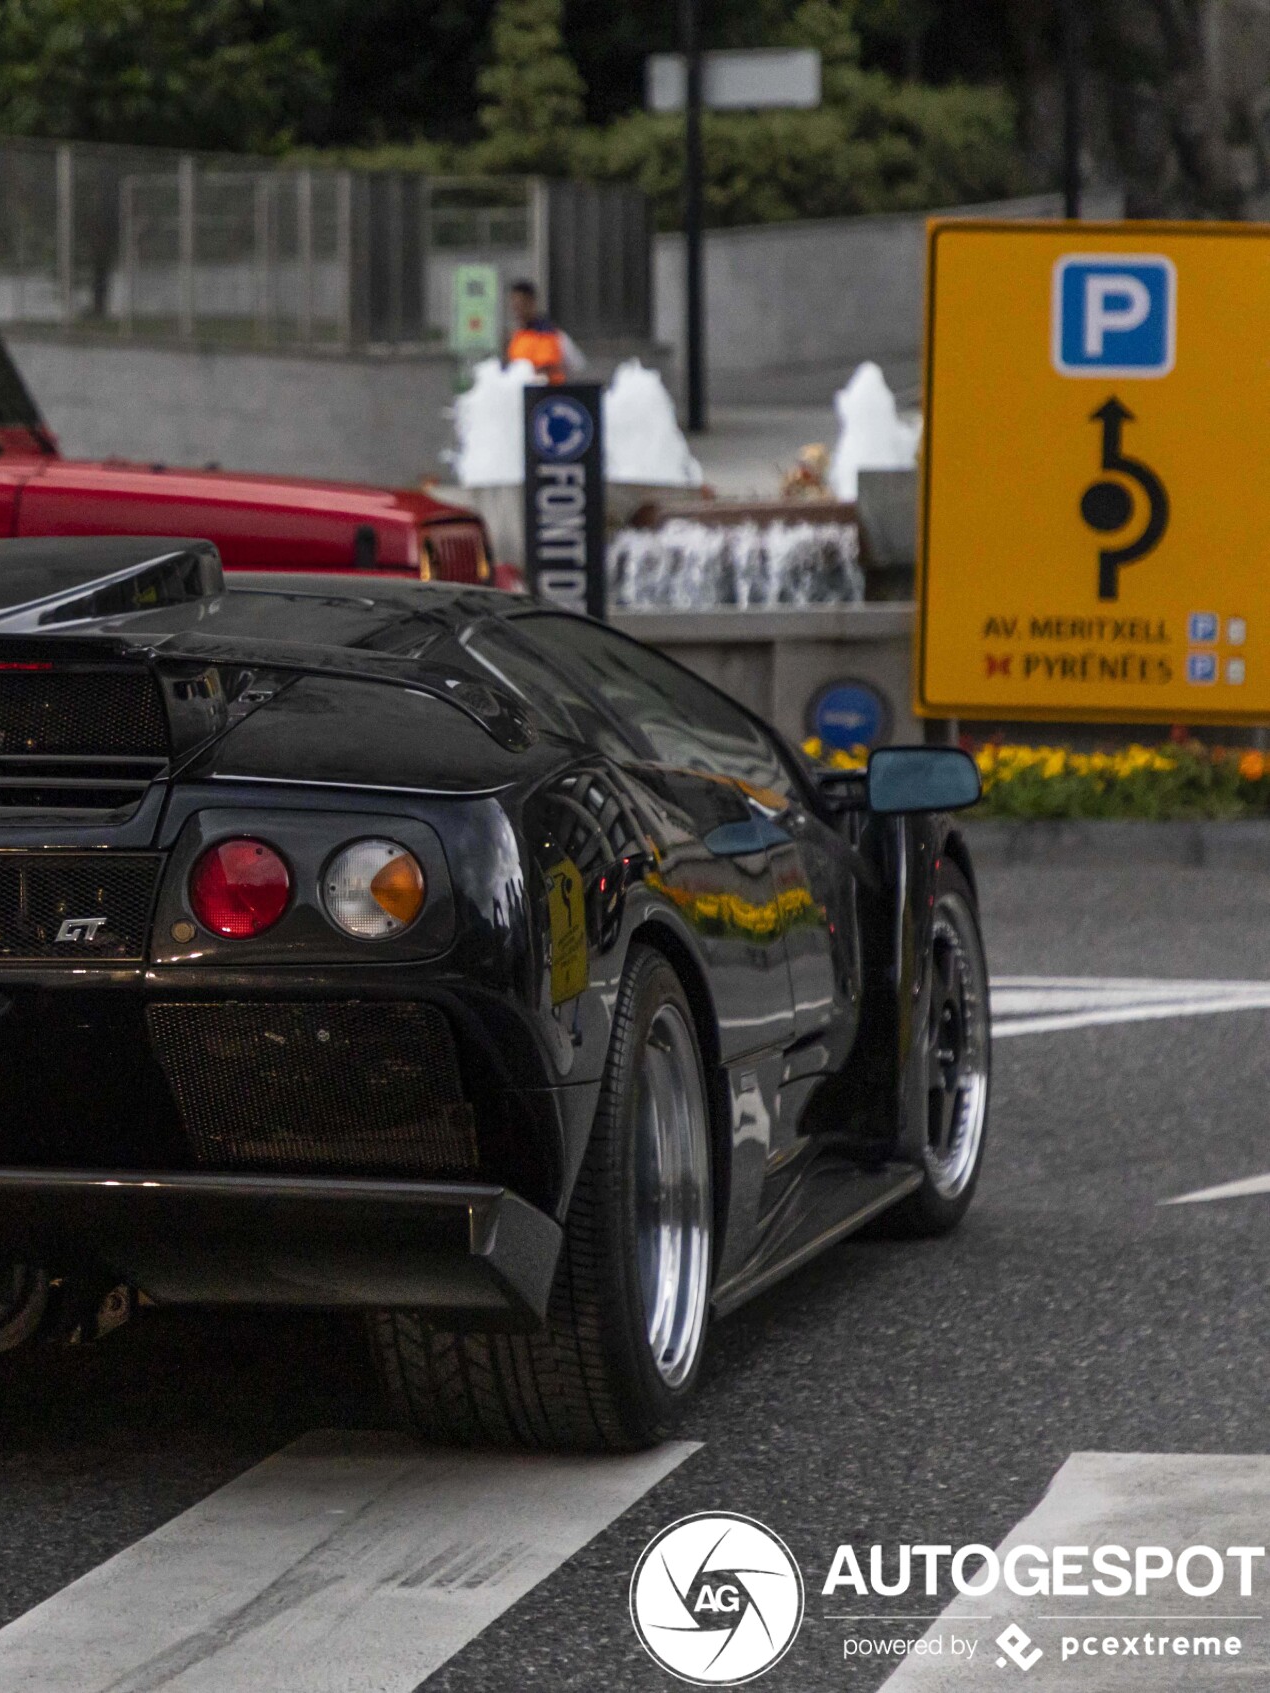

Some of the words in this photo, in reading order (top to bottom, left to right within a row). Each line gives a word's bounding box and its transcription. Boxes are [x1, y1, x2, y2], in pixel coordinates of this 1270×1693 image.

[1084, 274, 1151, 357] P
[536, 463, 587, 566] FONT
[1029, 615, 1172, 644] MERITXELL
[54, 917, 107, 942] GT
